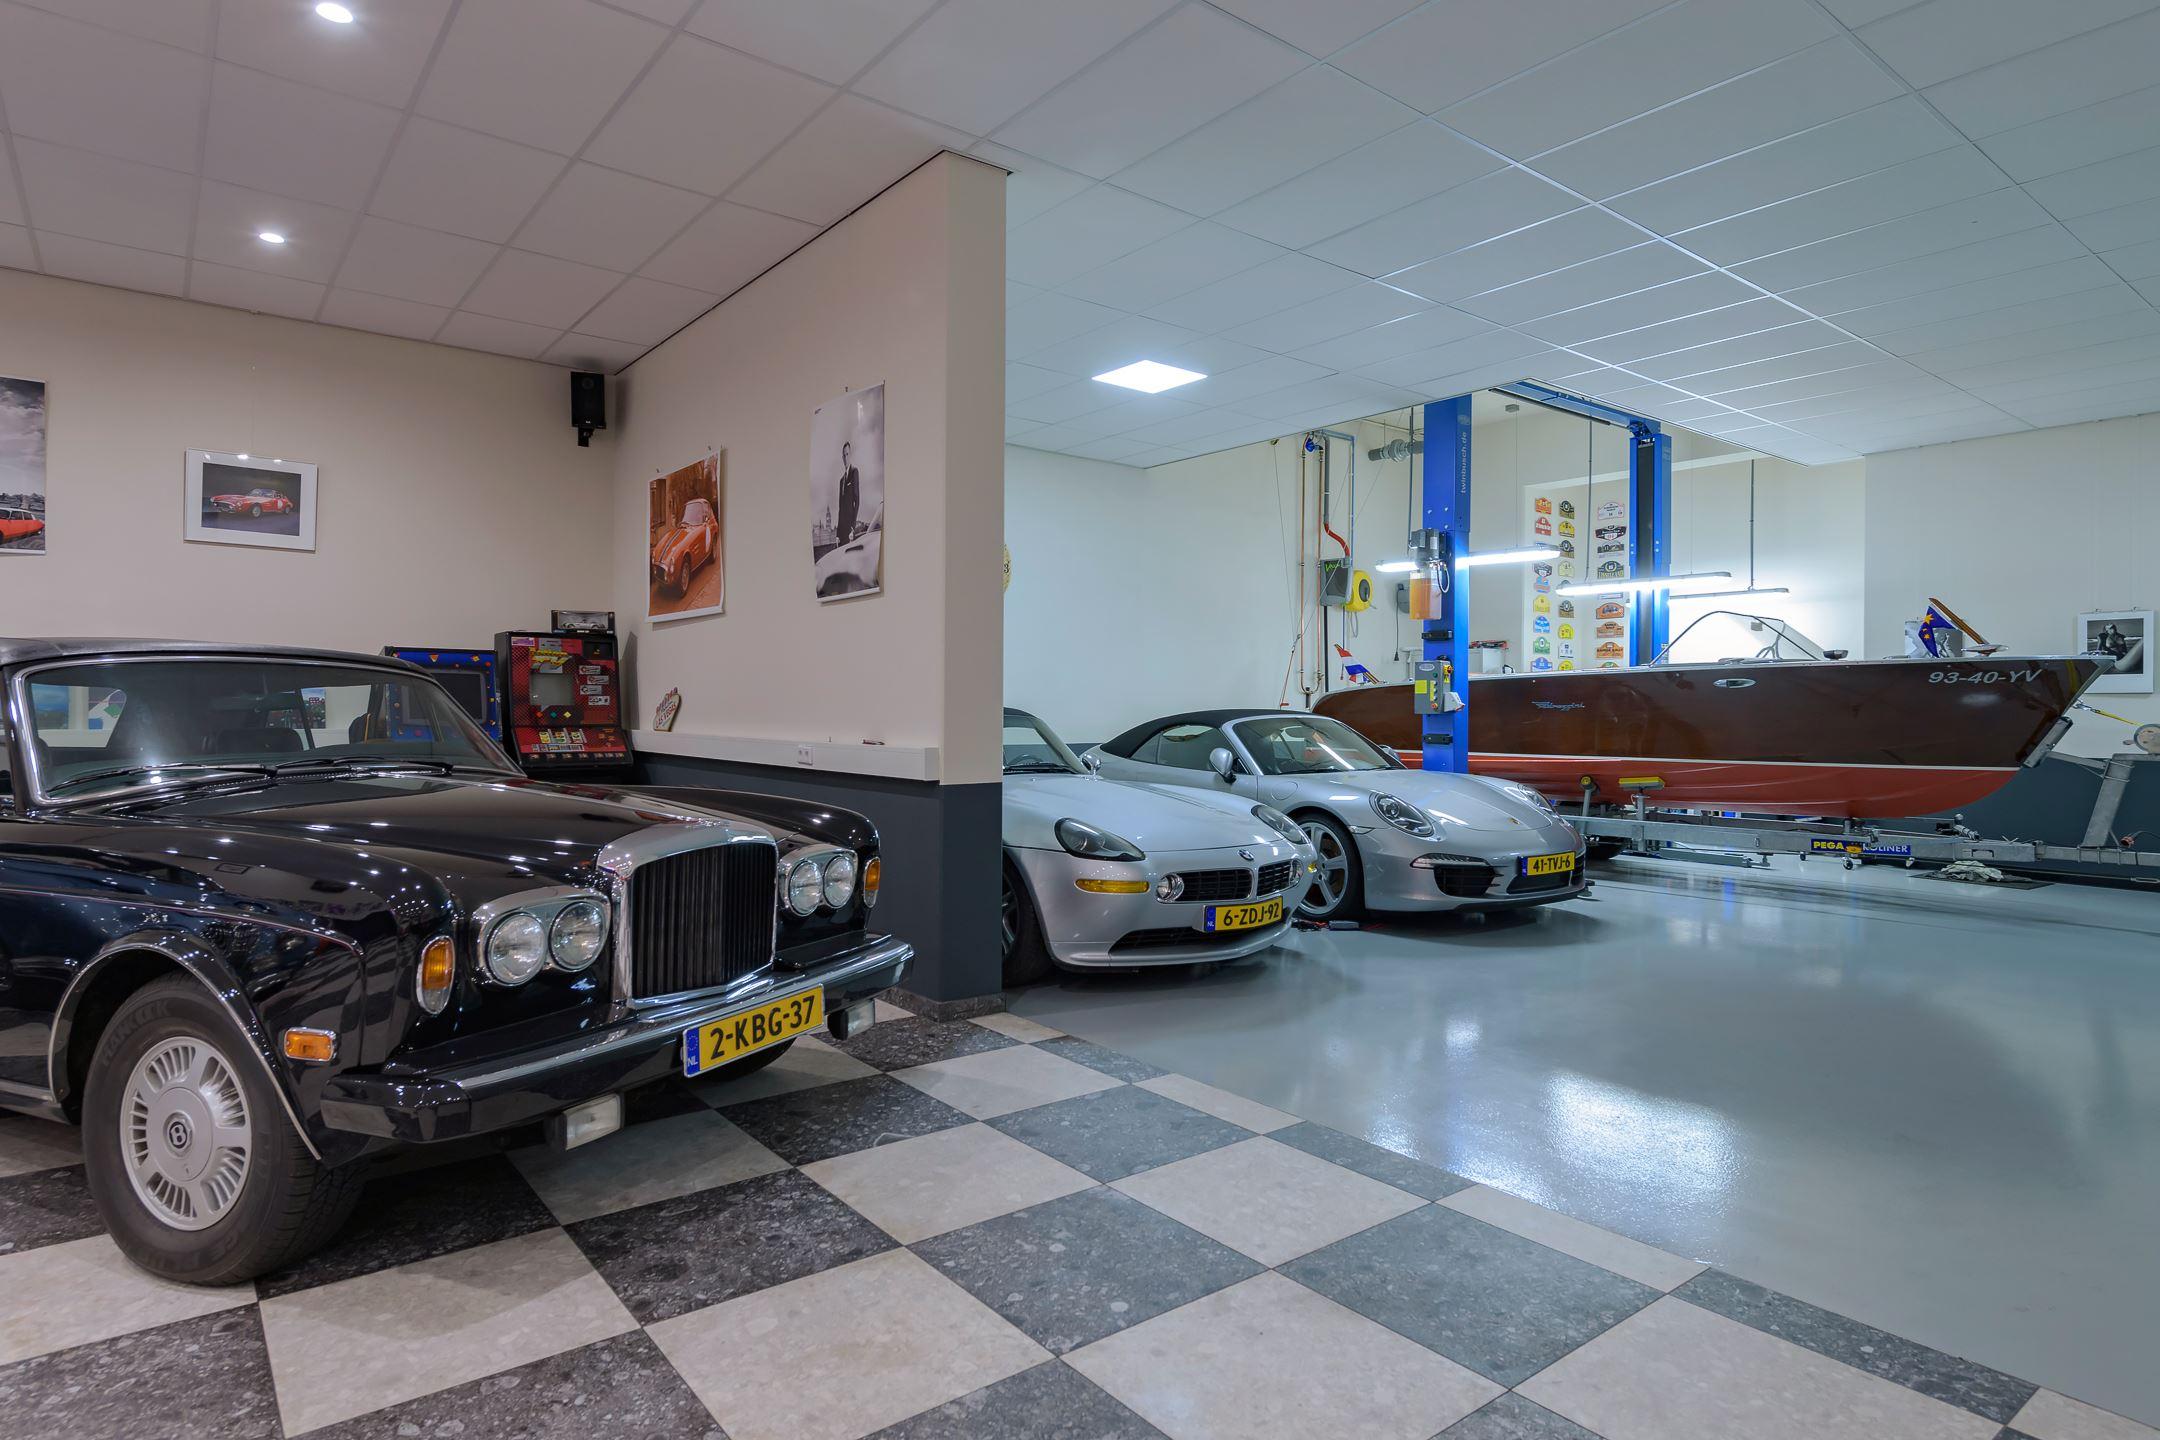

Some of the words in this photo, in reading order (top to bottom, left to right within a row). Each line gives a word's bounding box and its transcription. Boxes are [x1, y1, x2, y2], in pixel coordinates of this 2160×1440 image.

[1928, 668, 2041, 684] 93-40-YV
[1813, 841, 1844, 850] PEGA
[1532, 856, 1571, 872] 41-TVJ-6
[1223, 903, 1279, 926] 6-ZDJ-92
[687, 1056, 698, 1067] NL
[710, 995, 815, 1060] 2-KBG-37
